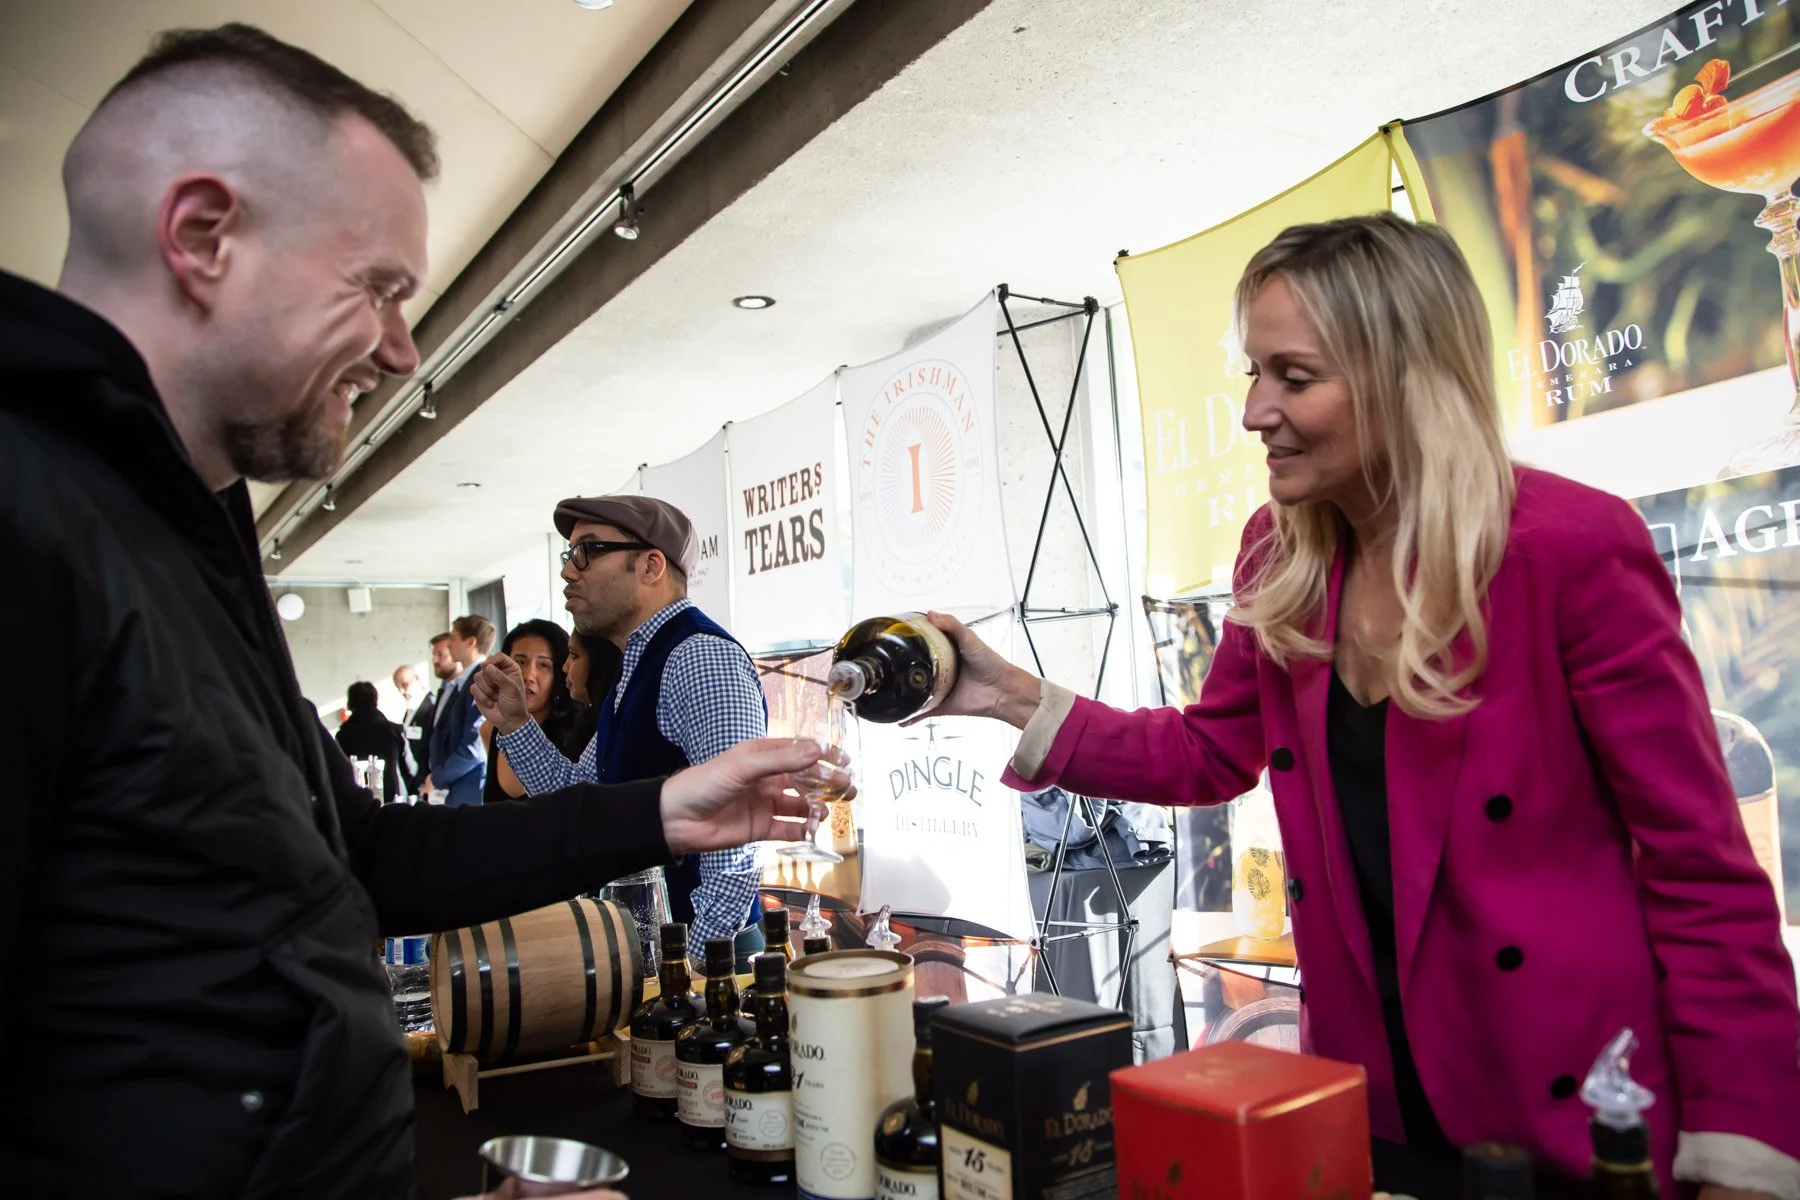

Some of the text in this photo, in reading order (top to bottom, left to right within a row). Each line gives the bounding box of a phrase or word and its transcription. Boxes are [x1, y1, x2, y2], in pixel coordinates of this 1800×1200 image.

[1564, 0, 1788, 103] CRAFT
[1535, 358, 1634, 390] EMERARA
[1539, 323, 1643, 374] DORADO
[1545, 376, 1614, 407] RUM
[861, 366, 975, 471] THE IRISHMAN
[907, 442, 925, 515] I
[700, 534, 719, 560] AM
[745, 508, 825, 576] TEARS
[889, 756, 984, 807] DINGLE
[792, 1040, 824, 1061] RADO
